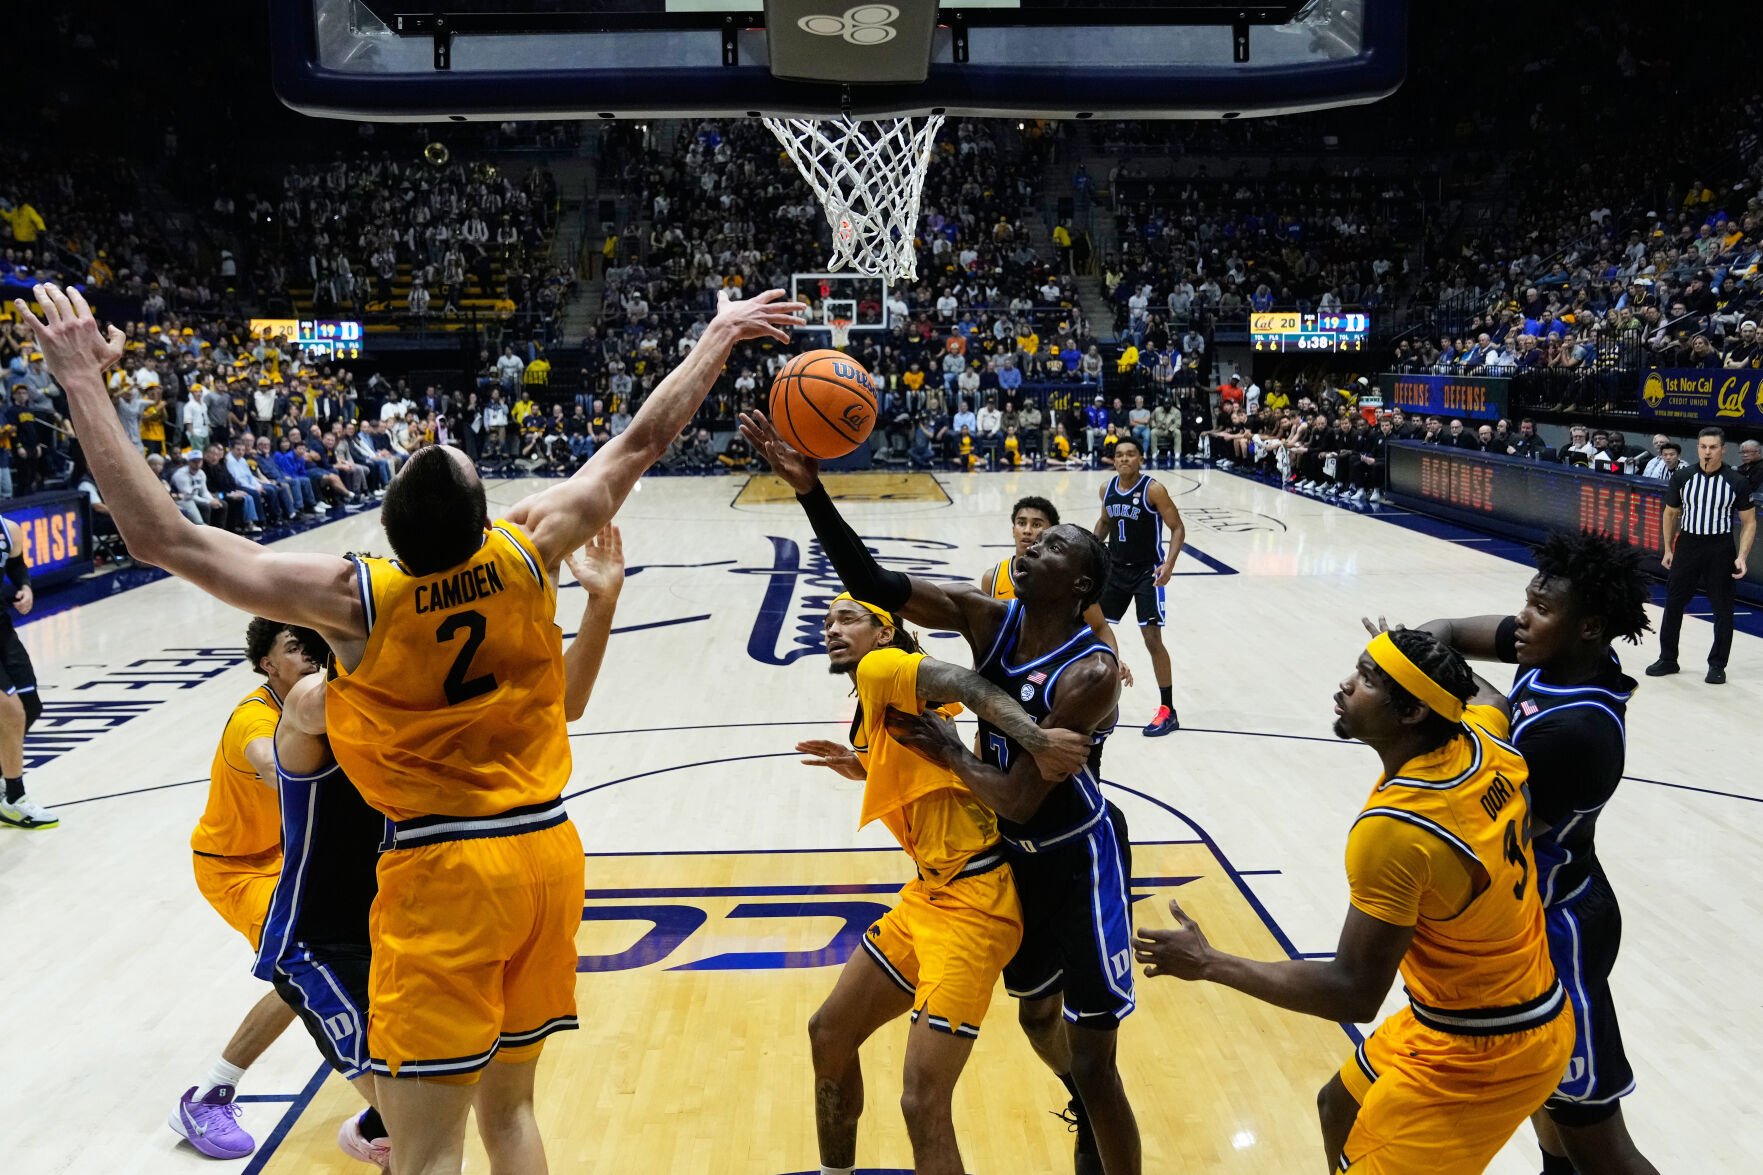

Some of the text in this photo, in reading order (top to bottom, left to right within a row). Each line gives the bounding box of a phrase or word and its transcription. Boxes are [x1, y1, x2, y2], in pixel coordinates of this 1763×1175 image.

[279, 325, 294, 336] 20
[320, 324, 336, 337] 19
[1254, 315, 1296, 331] Cal 20
[1306, 320, 1312, 331] 1
[1323, 317, 1340, 329] 19
[303, 327, 310, 340] 1
[1298, 336, 1328, 349] 6:38
[336, 349, 358, 359] 4 3
[1255, 341, 1277, 351] 4 6
[1340, 341, 1347, 351] 4
[1394, 382, 1429, 407] DEFENSE
[1665, 378, 1713, 393] 1st Nor Cal
[1444, 384, 1487, 412] DEFENSE
[1668, 397, 1708, 407] CREDIT UNION
[1716, 376, 1751, 418] Cal
[838, 403, 870, 432] Cal
[1422, 457, 1494, 512] DEFENSE
[1106, 503, 1141, 521] DUKE
[1580, 485, 1661, 550] DEFEN
[20, 511, 78, 568] ENSE
[1118, 519, 1126, 542] 1
[415, 560, 504, 614] CAMDEN
[436, 610, 499, 706] 2
[989, 732, 1009, 774] 7
[1480, 770, 1515, 822] DORT
